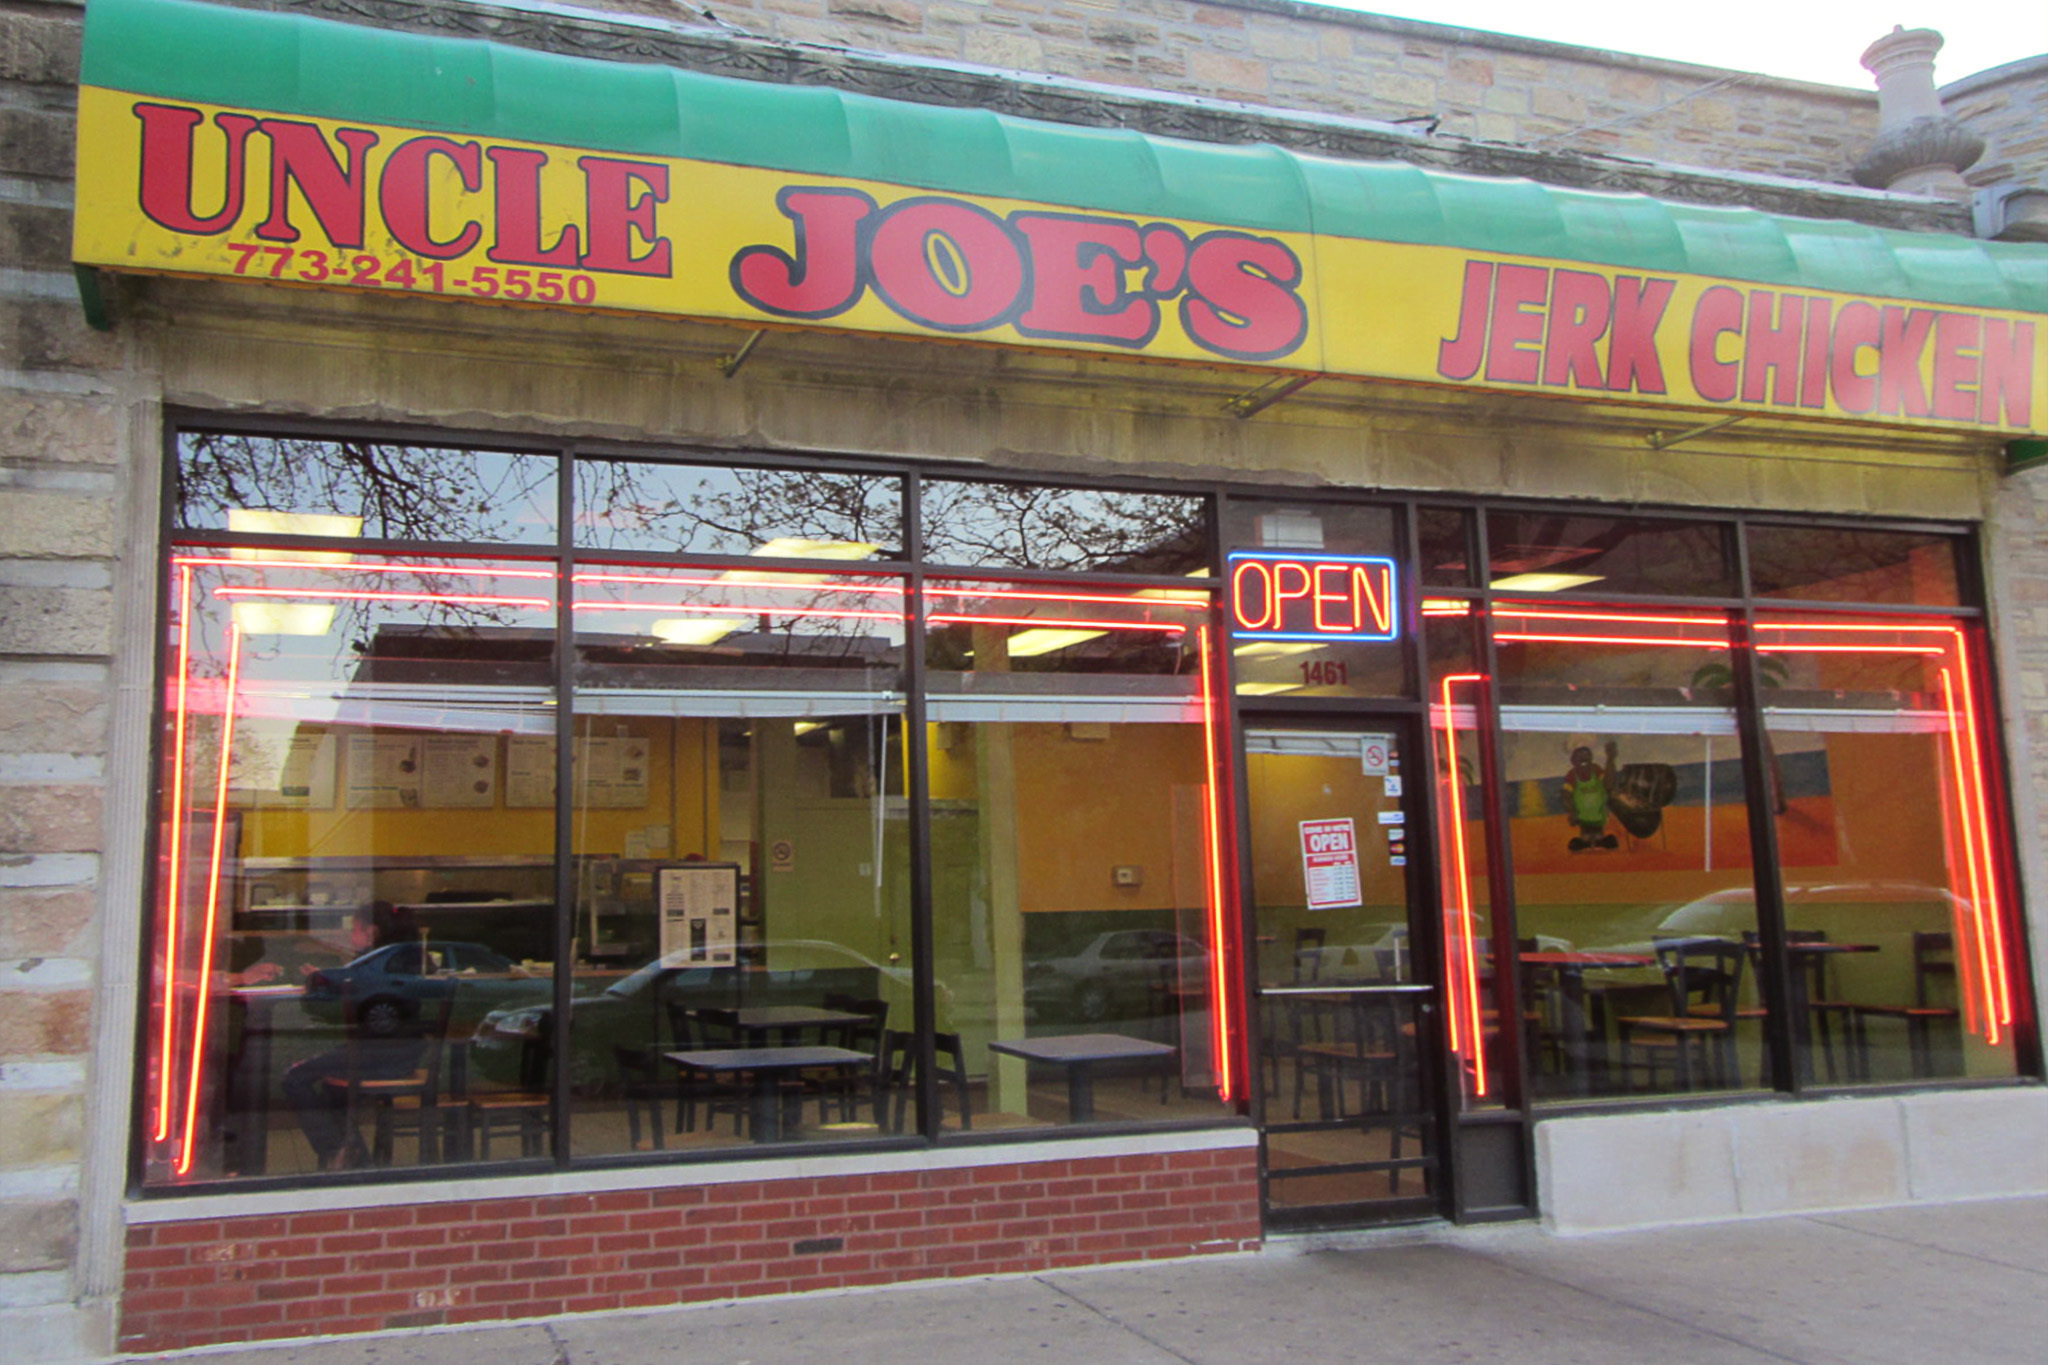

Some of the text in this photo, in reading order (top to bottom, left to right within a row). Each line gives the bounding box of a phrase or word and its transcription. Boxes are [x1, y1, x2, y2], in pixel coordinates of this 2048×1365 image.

[132, 102, 1308, 361] UNCLE JOE'S
[227, 242, 597, 305] 773-241-5550
[1437, 259, 2036, 428] JERK CHICKEN
[1233, 559, 1391, 632] OPEN
[1300, 660, 1348, 685] 1461
[1310, 833, 1349, 852] OPEN
